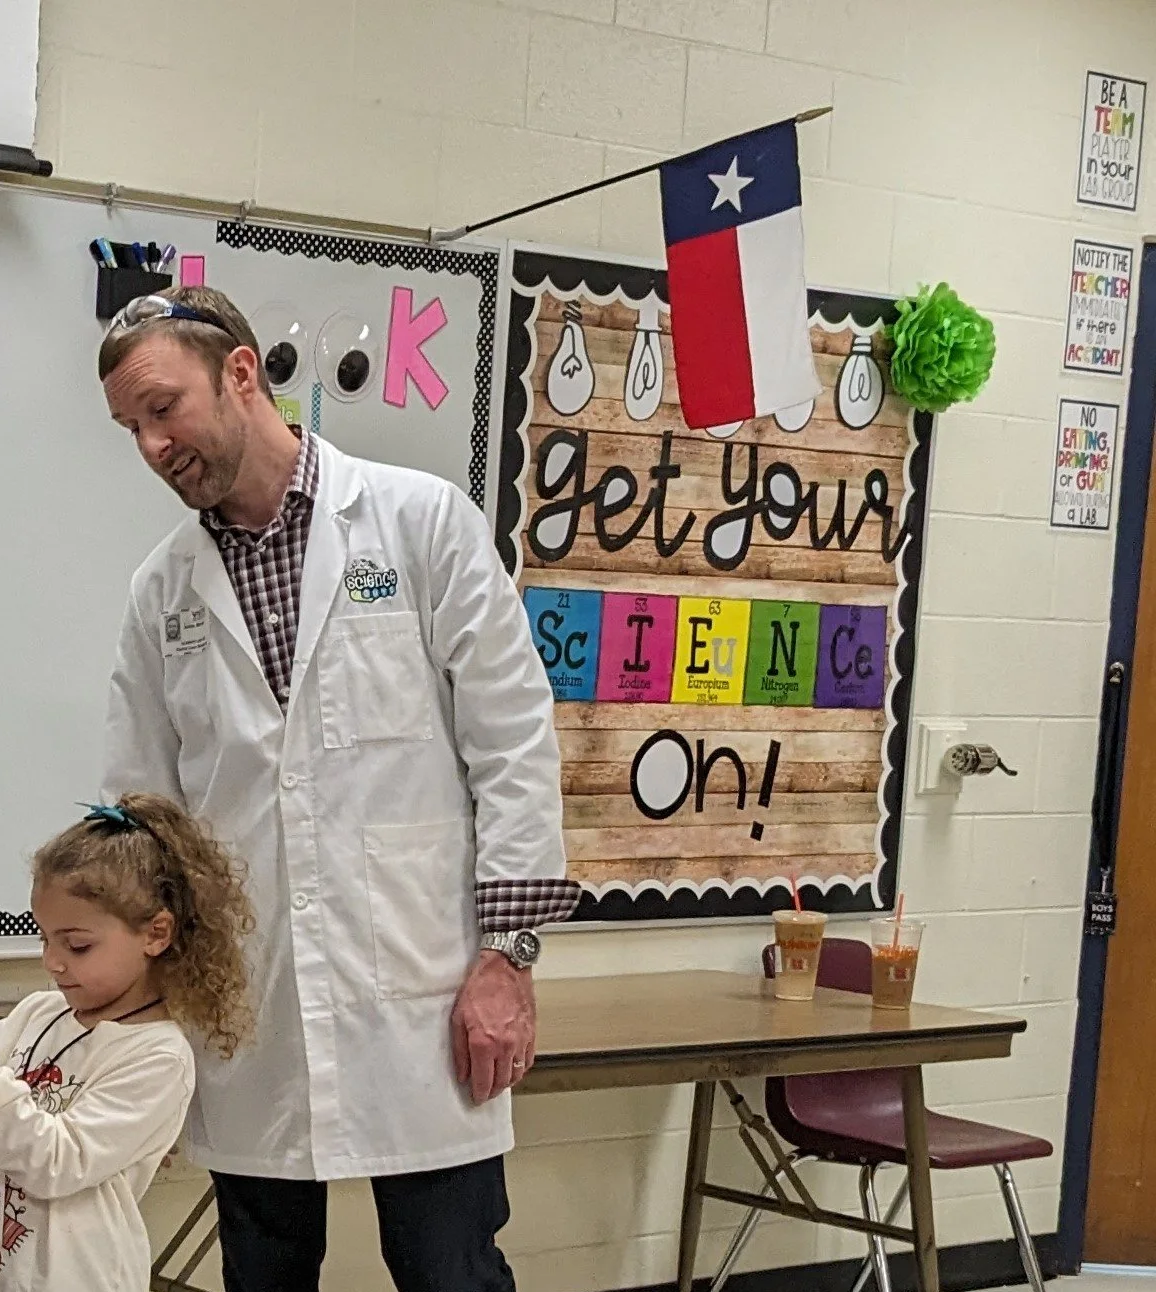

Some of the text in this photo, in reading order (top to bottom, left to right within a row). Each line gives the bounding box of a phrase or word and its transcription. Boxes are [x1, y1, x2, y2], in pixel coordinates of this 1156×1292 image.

[1100, 79, 1128, 109] BE A
[1094, 105, 1135, 140] TEAM
[1101, 159, 1134, 180] your
[1076, 247, 1129, 273] NOTIFY THE
[1072, 271, 1131, 299] TEACHER
[1067, 343, 1120, 367] ACCIDENT
[1080, 406, 1097, 428] NO
[1060, 470, 1105, 492] or GUM
[528, 429, 912, 571] get your
[557, 592, 571, 609] 21
[708, 601, 721, 615] 63
[783, 604, 791, 618] 7
[766, 620, 800, 677] N
[687, 675, 730, 694] Europium
[760, 676, 799, 695] Nitrogen
[629, 729, 781, 842] On!
[1091, 903, 1113, 912] BOYS
[1091, 913, 1112, 922] PASS
